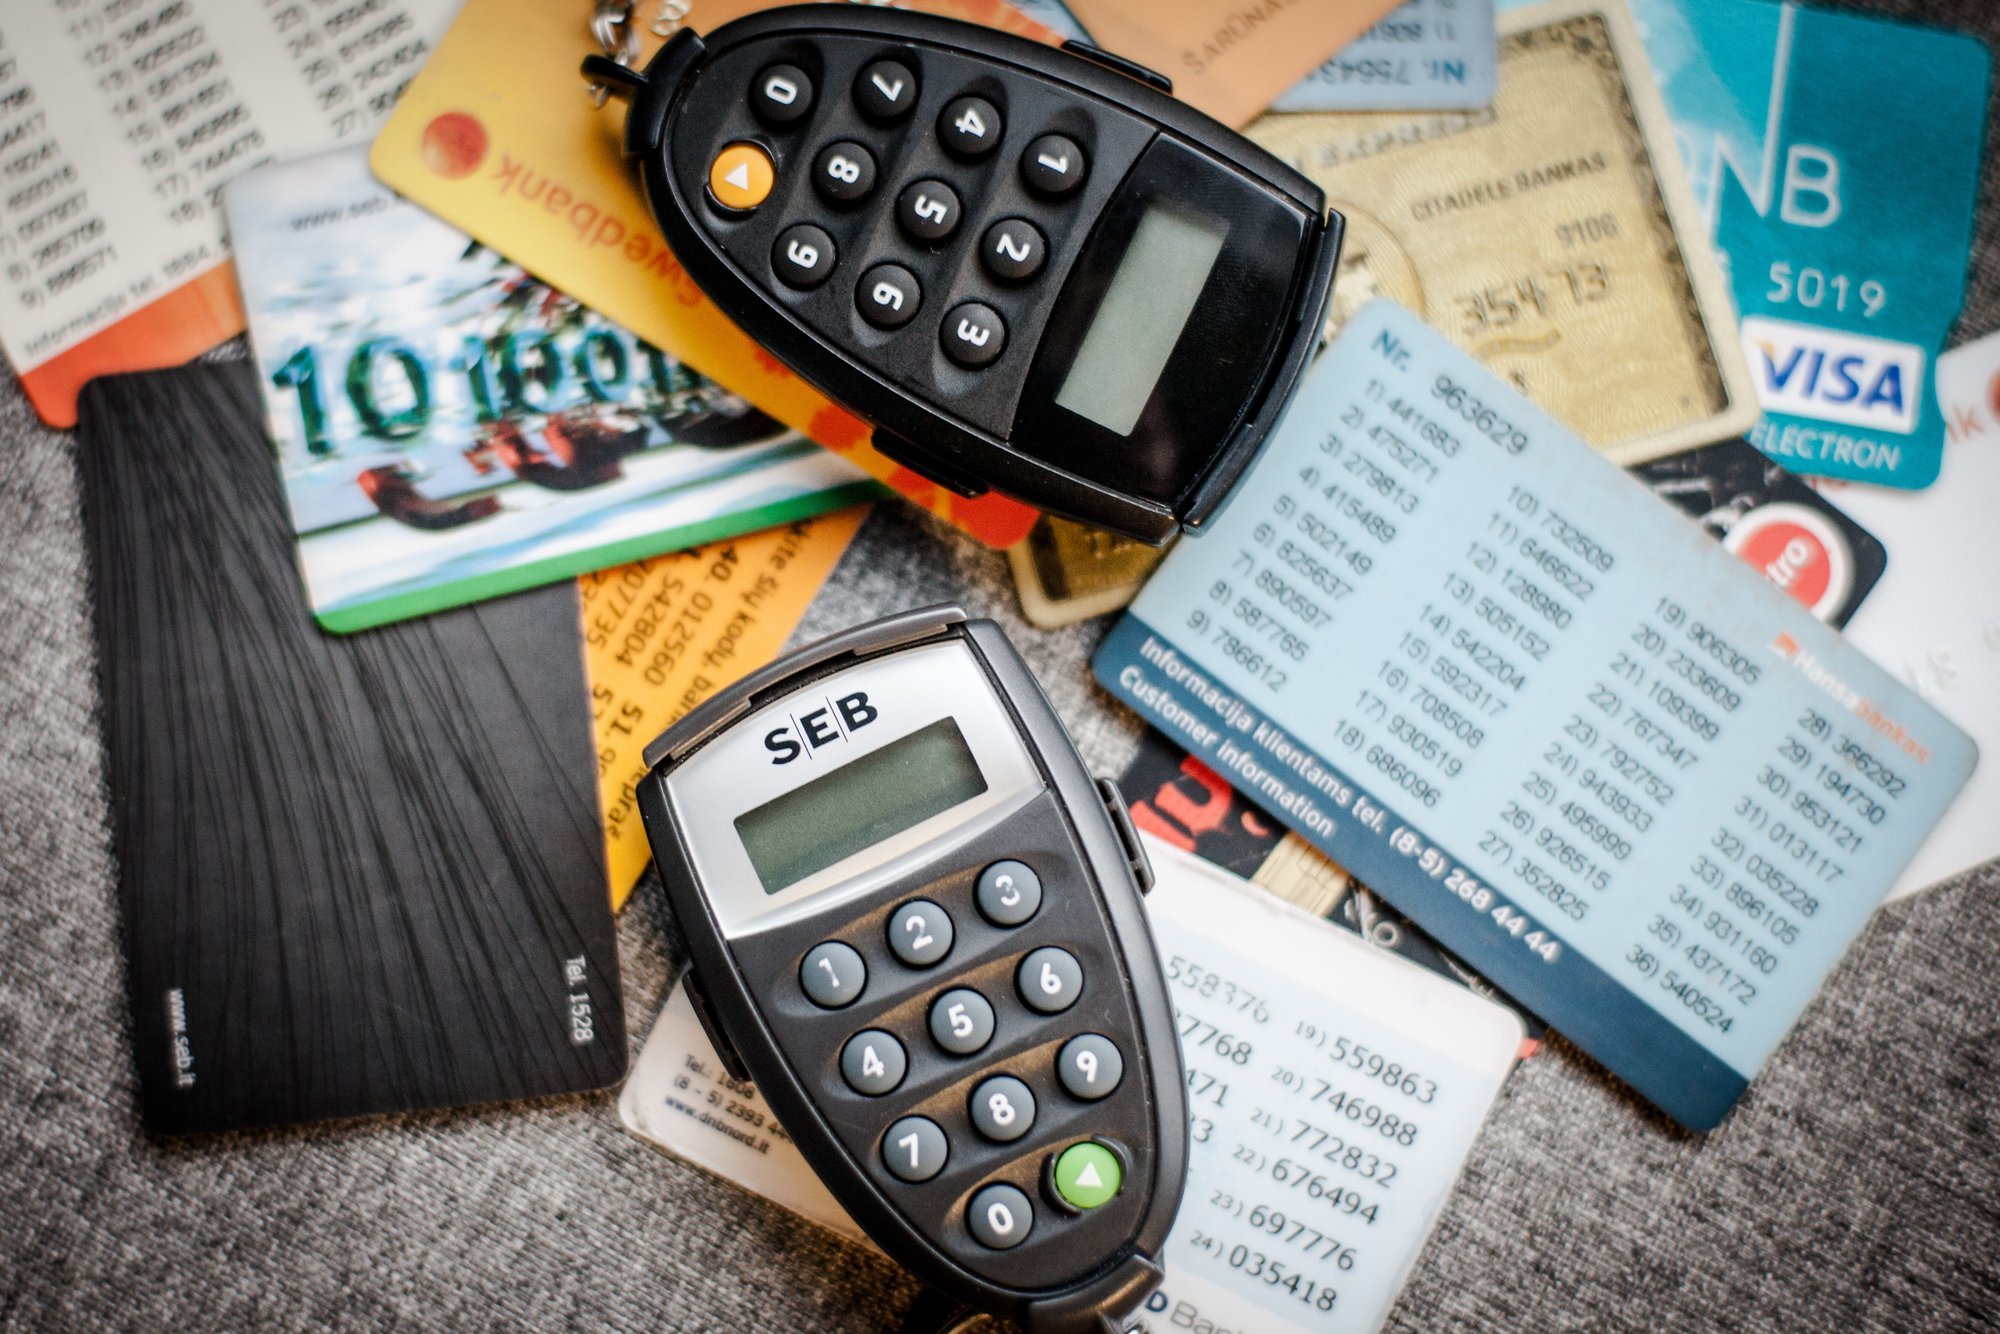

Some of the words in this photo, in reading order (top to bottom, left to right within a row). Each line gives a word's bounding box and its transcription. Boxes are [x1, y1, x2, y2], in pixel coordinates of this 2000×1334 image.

[766, 78, 797, 104] 0
[873, 75, 902, 101] 7
[956, 109, 985, 137] 4
[829, 156, 859, 183] 8
[1038, 154, 1068, 173] 1
[1516, 152, 1606, 187] BANKAS
[915, 196, 947, 224] 5
[997, 234, 1030, 261] 2
[788, 241, 818, 268] 9
[1767, 262, 1886, 317] 5019
[873, 282, 903, 310] 6
[958, 319, 991, 347] 3
[1365, 378, 1385, 402] 1)
[1388, 398, 1461, 457] 441683
[1372, 329, 1410, 370] Nr.
[1432, 375, 1528, 454] 963629
[1758, 342, 1906, 416] VISA
[1319, 433, 1343, 457] 3)
[1343, 452, 1419, 513] 279813
[1340, 404, 1365, 429] 2)
[1367, 425, 1439, 482] 475271
[1748, 419, 1900, 472] ELECTRON
[1273, 494, 1296, 520] 5)
[1297, 512, 1373, 575] 502149
[1299, 466, 1320, 488] 4)
[1323, 484, 1396, 543] 415489
[1508, 484, 1540, 517] 10)
[1542, 510, 1615, 572] 732509
[1232, 549, 1255, 576] 7)
[1255, 569, 1332, 627] 890597
[1253, 522, 1276, 547] 6)
[1276, 540, 1353, 599] 825637
[1466, 541, 1498, 574] 12)
[1502, 569, 1572, 629] 128980
[1488, 512, 1519, 545] 11)
[1520, 538, 1594, 601] 646622
[615, 574, 684, 666] 542804
[643, 592, 713, 686] 012560
[1187, 610, 1210, 634] 9)
[1212, 627, 1287, 691] 786612
[1209, 580, 1232, 604] 8)
[1233, 597, 1309, 661] 587765
[1420, 605, 1451, 636] 14)
[1452, 629, 1526, 691] 542204
[1444, 572, 1475, 605] 13)
[1475, 597, 1550, 661] 505152
[1656, 597, 1687, 629] 19)
[1687, 623, 1762, 684] 906305
[1378, 660, 1409, 693] 16)
[1411, 685, 1485, 748] 708508
[1400, 632, 1431, 664] 15)
[1431, 656, 1508, 716] 592317
[1610, 652, 1645, 686] 21)
[1650, 681, 1720, 741] 109399
[1631, 624, 1666, 657] 20)
[1667, 651, 1742, 712] 233609
[1120, 666, 1219, 747] Customer
[1216, 739, 1334, 837] information
[1335, 720, 1365, 752] 18)
[1367, 745, 1441, 807] 686096
[1356, 690, 1388, 722] 17)
[1388, 715, 1463, 777] 930519
[1564, 714, 1599, 749] 23)
[1601, 743, 1674, 806] 792752
[1587, 682, 1623, 717] 22)
[1624, 709, 1699, 769] 767347
[1799, 709, 1832, 742] 28)
[1834, 736, 1907, 799] 366292
[1140, 637, 1255, 733] Informacija
[1253, 722, 1352, 806] klientams
[1352, 796, 1384, 833] tel.
[1390, 827, 1446, 877] (8-5)
[1444, 869, 1493, 911] 268
[1491, 906, 1526, 936] 44
[1524, 931, 1559, 961] 44
[1522, 771, 1557, 805] 25)
[1560, 801, 1632, 861] 495999
[1543, 742, 1579, 777] 24)
[1579, 769, 1654, 832] 943933
[1757, 765, 1792, 799] 30)
[1792, 792, 1863, 853] 953121
[1778, 736, 1812, 769] 29)
[1818, 765, 1887, 825] 194730
[1478, 830, 1514, 865] 27)
[1514, 858, 1589, 920] 352825
[1500, 801, 1535, 835] 26)
[1536, 828, 1611, 890] 926515
[1711, 828, 1746, 862] 32)
[1746, 855, 1820, 918] 035228
[1735, 796, 1769, 830] 31)
[1769, 823, 1845, 882] 013117
[996, 875, 1020, 905] 3
[1670, 885, 1704, 919] 34)
[1704, 912, 1778, 975] 931160
[1691, 855, 1725, 890] 33)
[1726, 883, 1800, 945] 896105
[565, 955, 586, 986] Tel.
[906, 914, 934, 949] 2
[1648, 914, 1682, 948] 35)
[1685, 944, 1758, 1006] 437172
[819, 958, 841, 987] 1
[1041, 961, 1063, 995] 6
[1626, 945, 1660, 978] 36)
[1661, 971, 1734, 1033] 540524
[569, 993, 593, 1043] 1528
[948, 1003, 975, 1037] 5
[685, 1055, 712, 1079] Tel.:
[863, 1044, 886, 1077] 4
[1077, 1051, 1097, 1082] 9
[1296, 1022, 1326, 1048] 19)
[1330, 1037, 1437, 1104] 559863
[725, 1101, 766, 1128] 2393
[989, 1093, 1015, 1126] 8
[1271, 1067, 1304, 1093] 20)
[1312, 1081, 1417, 1146] 746988
[899, 1132, 921, 1168] 7
[1232, 1144, 1266, 1172] 22)
[1272, 1159, 1379, 1225] 676494
[1250, 1108, 1283, 1135] 21)
[1291, 1121, 1397, 1189] 772832
[988, 1203, 1013, 1234] 0
[1210, 1190, 1244, 1218] 23)
[1249, 1205, 1356, 1271] 697776
[1190, 1231, 1223, 1258] 24)
[1229, 1245, 1337, 1312] 035418
